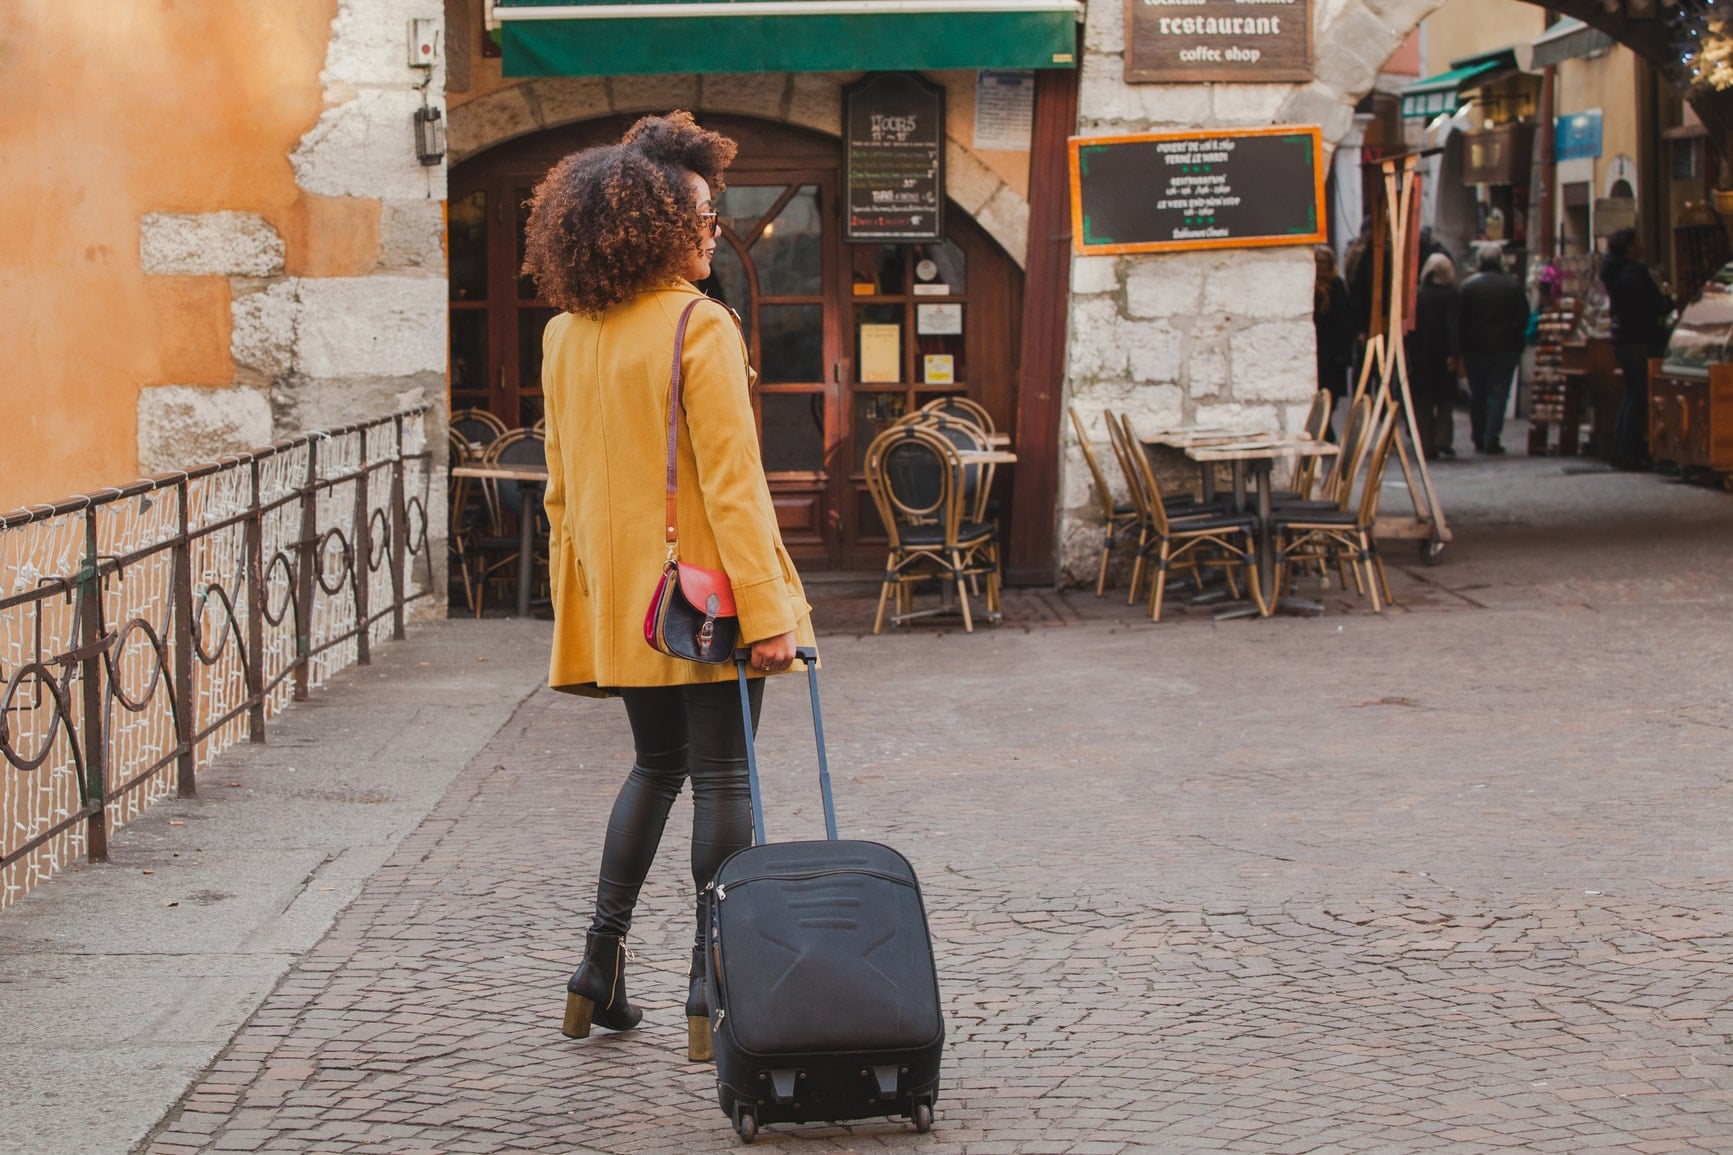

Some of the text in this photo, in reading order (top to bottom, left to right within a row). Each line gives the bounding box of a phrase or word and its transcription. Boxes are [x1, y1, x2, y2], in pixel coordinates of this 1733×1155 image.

[1159, 15, 1281, 35] restaurant
[1179, 46, 1261, 64] coffee shop
